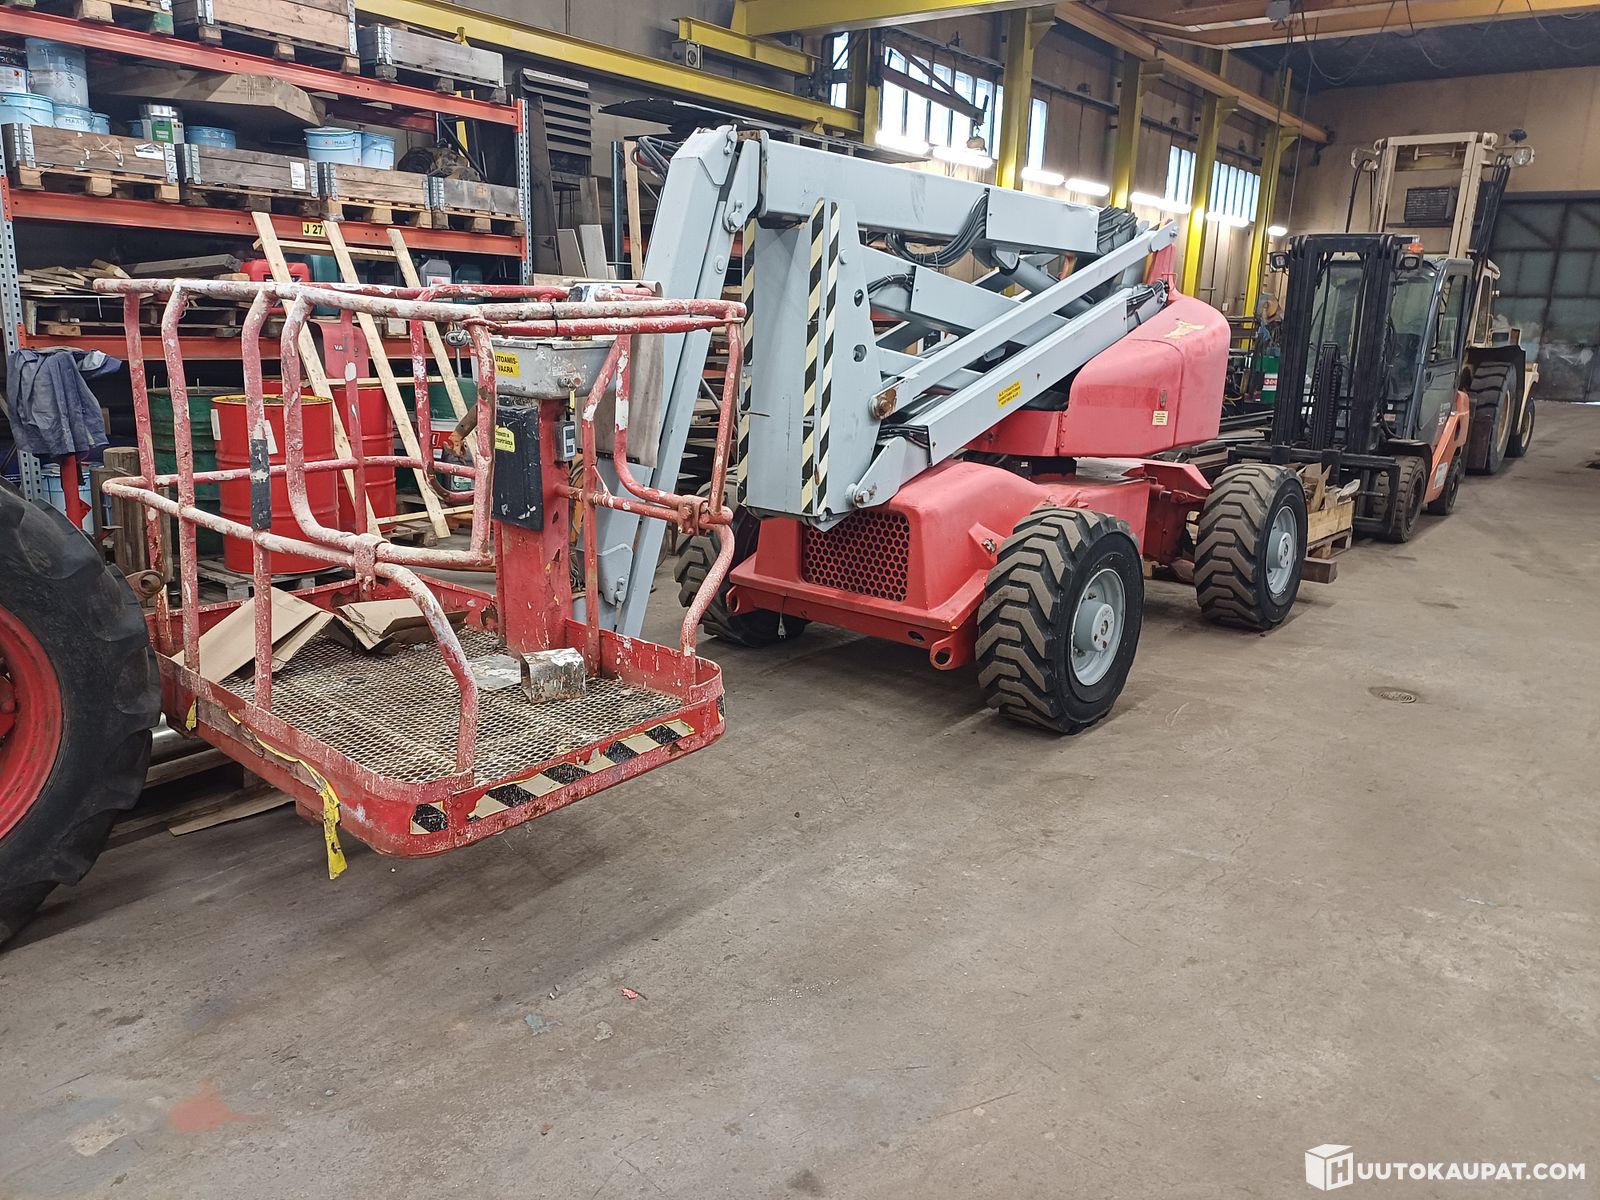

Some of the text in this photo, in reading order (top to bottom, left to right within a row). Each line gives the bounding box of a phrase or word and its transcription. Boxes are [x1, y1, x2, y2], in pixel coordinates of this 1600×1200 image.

[304, 224, 323, 235] J 27
[495, 355, 518, 365] UTOAMIS-
